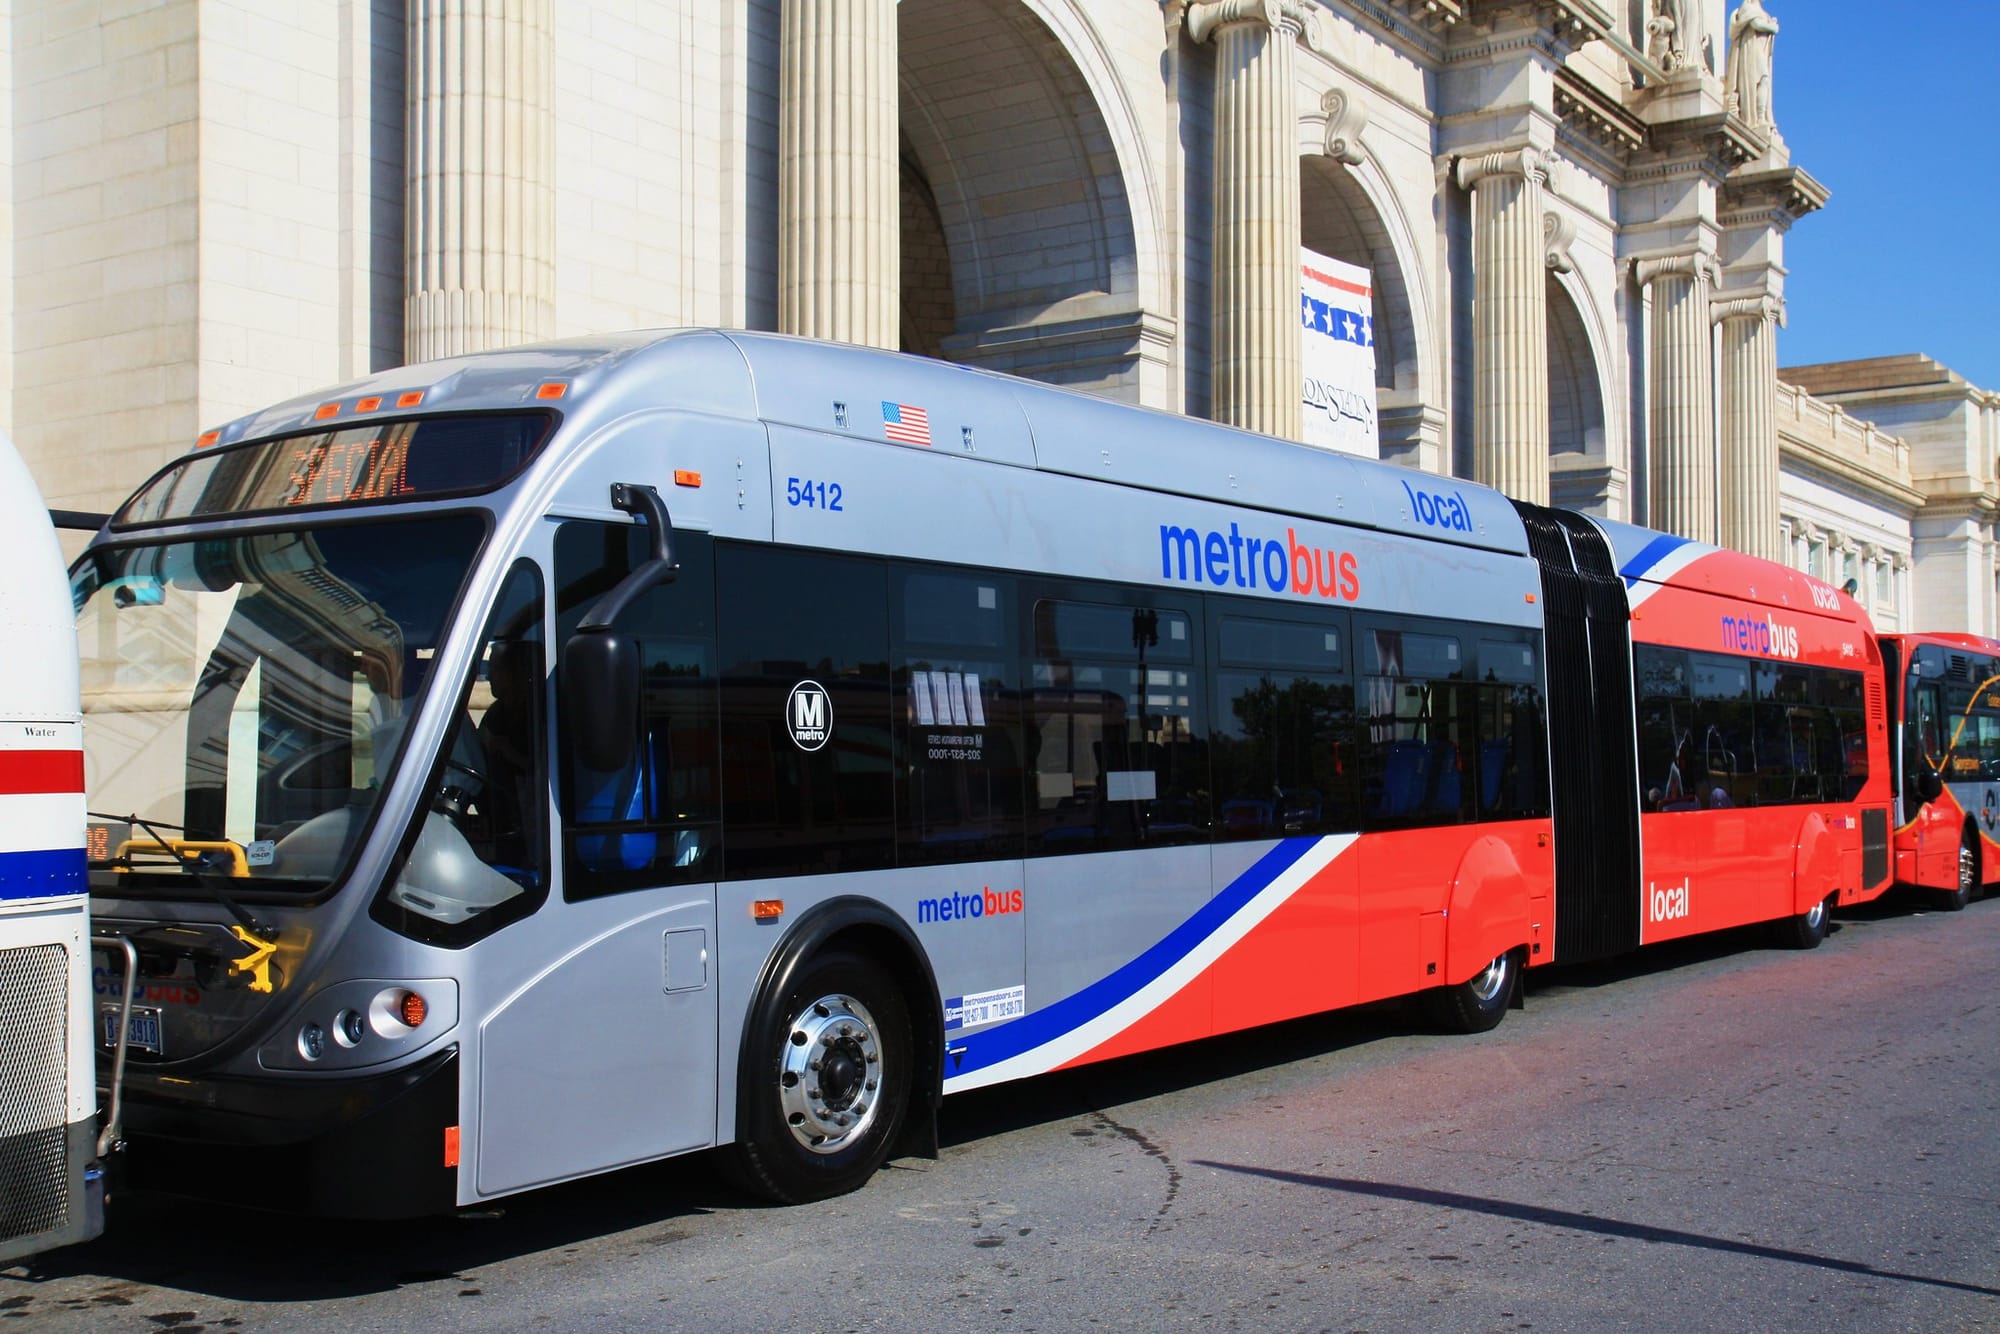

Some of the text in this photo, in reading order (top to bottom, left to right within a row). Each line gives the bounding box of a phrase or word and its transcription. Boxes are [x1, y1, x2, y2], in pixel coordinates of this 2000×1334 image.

[287, 436, 416, 505] SPECIAL
[787, 477, 843, 511] 5412
[1401, 480, 1473, 532] local
[1160, 522, 1360, 601] metrobus
[1805, 578, 1841, 611] local
[1721, 612, 1799, 659] metrobus
[797, 693, 823, 727] M
[24, 727, 56, 737] Water
[796, 729, 824, 741] metro
[918, 886, 1023, 924] metrobus
[1650, 876, 1689, 923] local
